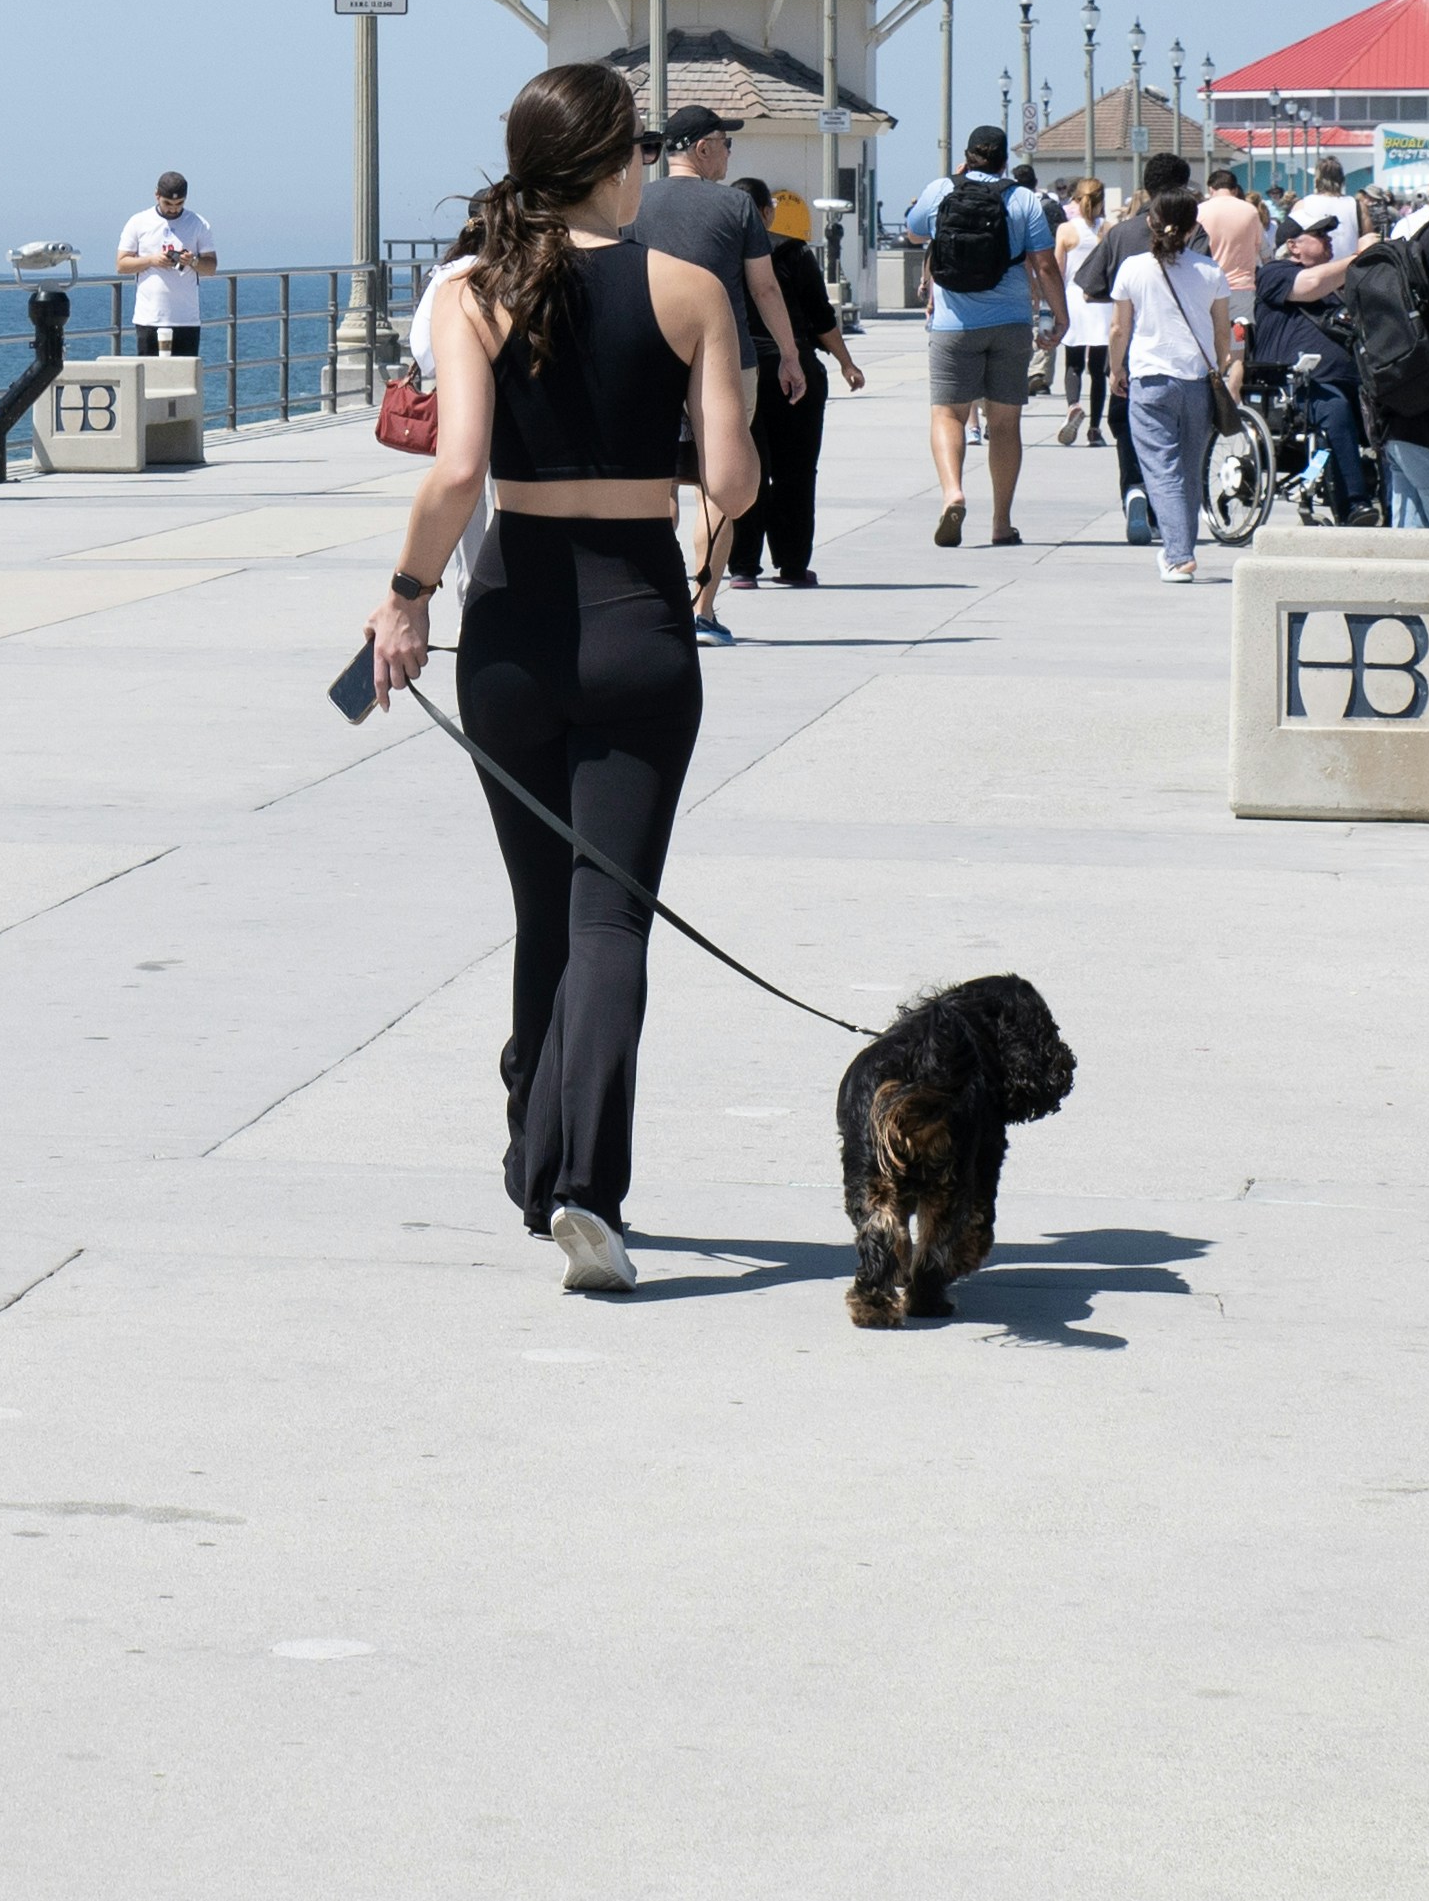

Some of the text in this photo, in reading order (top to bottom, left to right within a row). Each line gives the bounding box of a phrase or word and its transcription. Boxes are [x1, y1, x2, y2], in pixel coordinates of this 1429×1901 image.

[1384, 137, 1425, 149] BROAD
[55, 385, 117, 432] HB
[1286, 611, 1429, 719] HB
